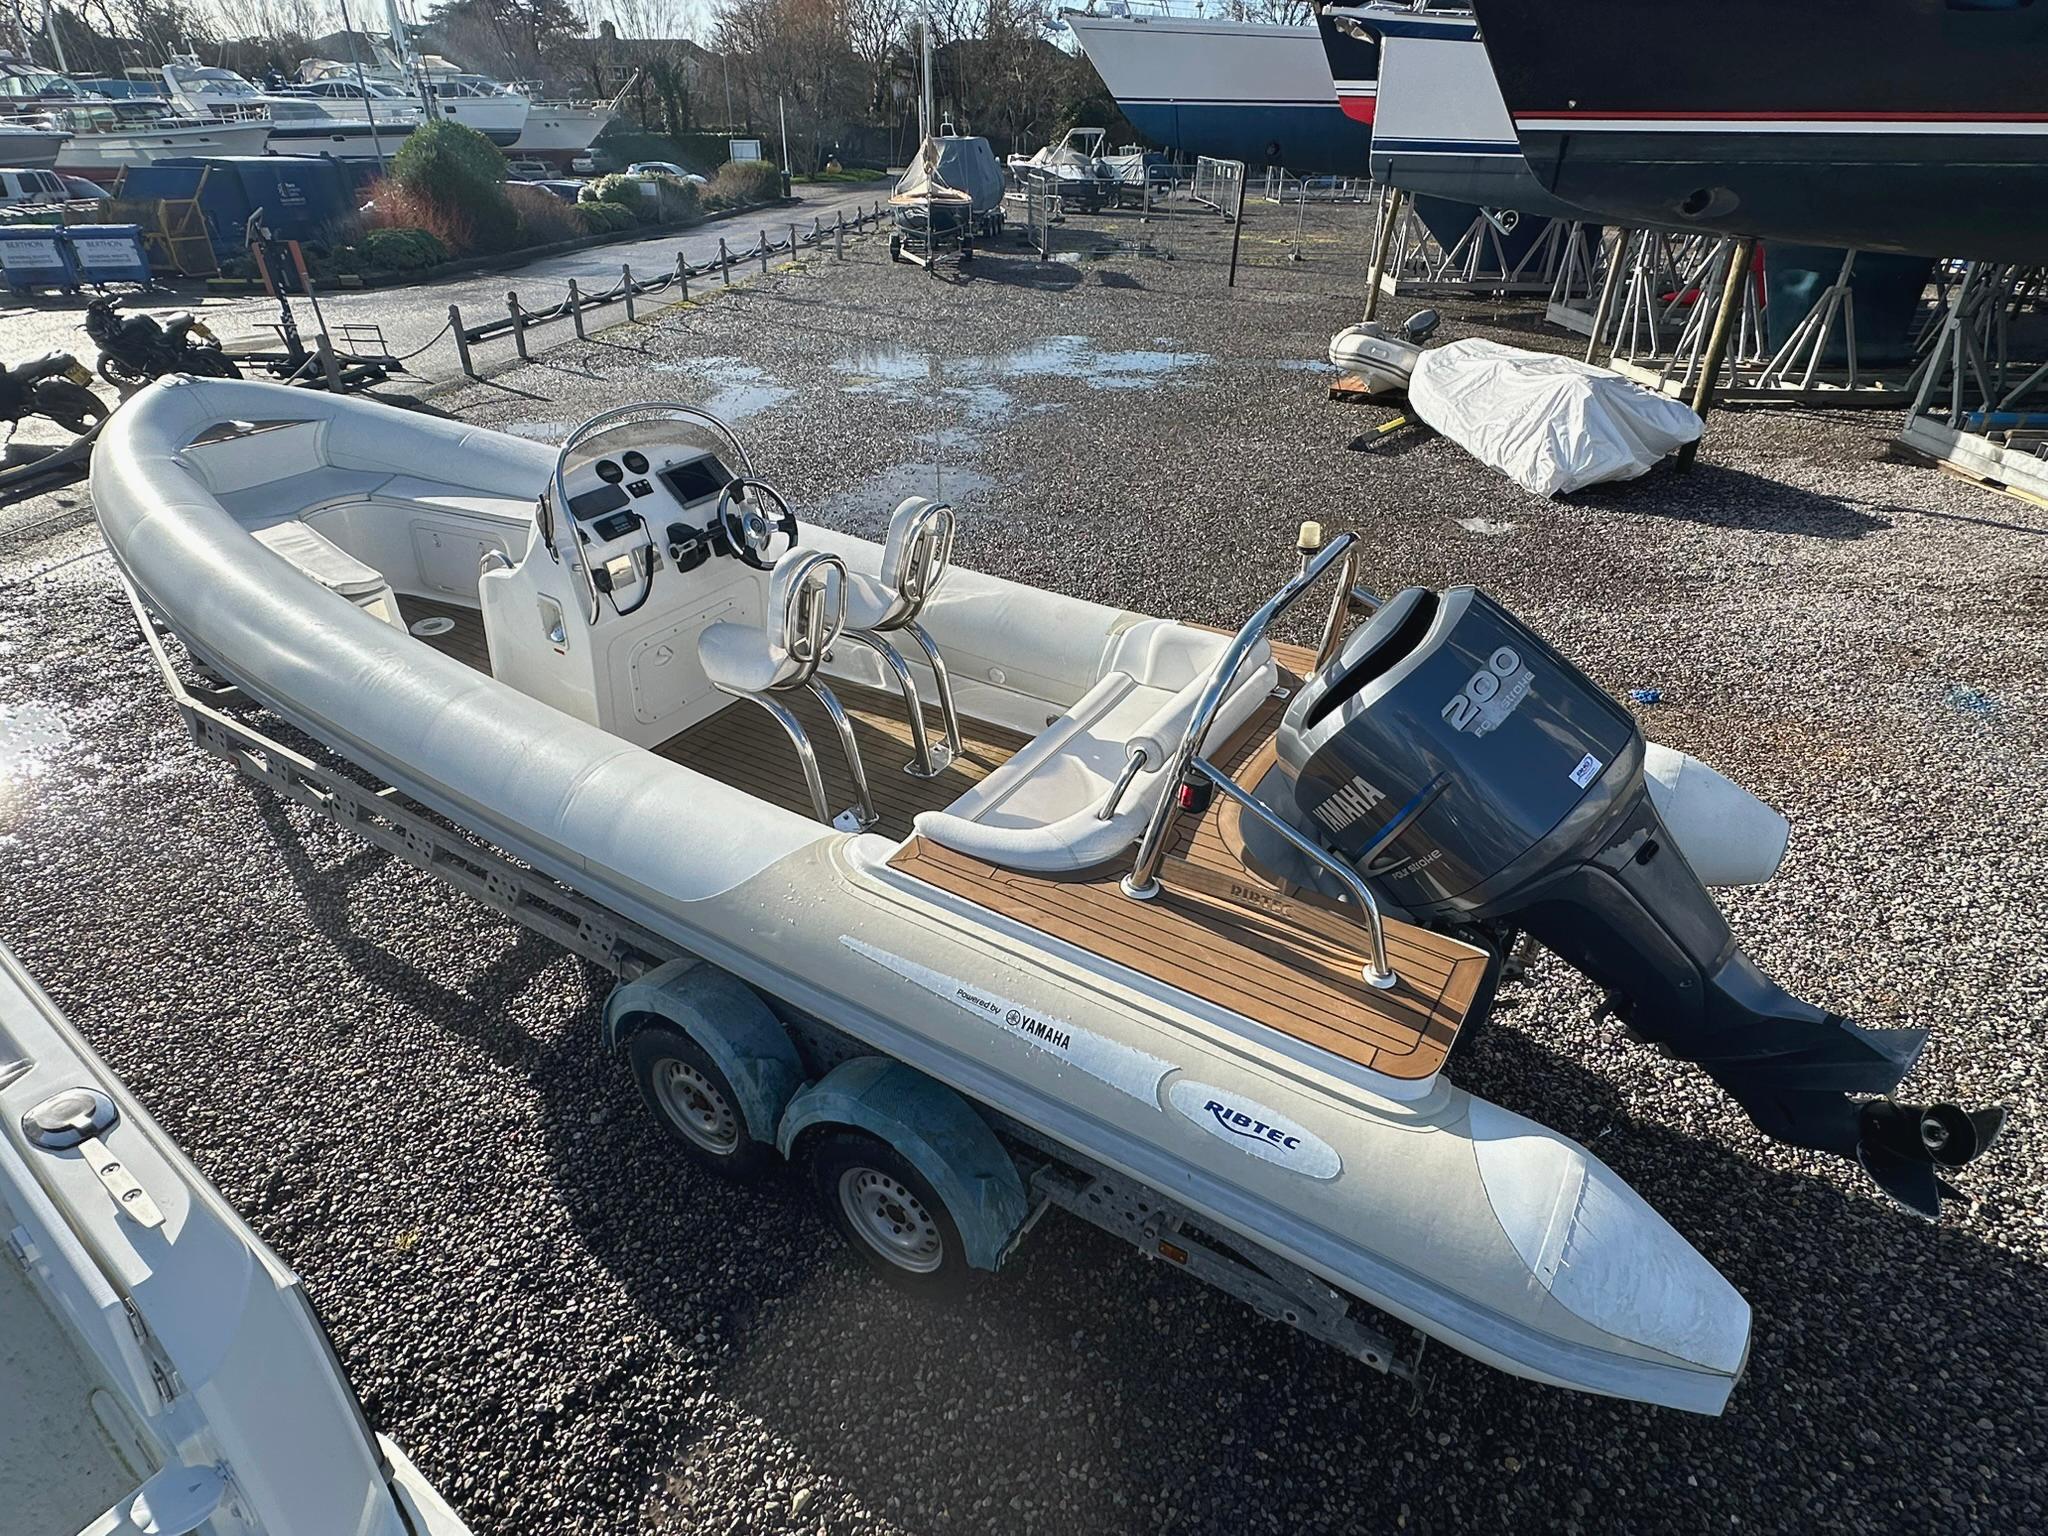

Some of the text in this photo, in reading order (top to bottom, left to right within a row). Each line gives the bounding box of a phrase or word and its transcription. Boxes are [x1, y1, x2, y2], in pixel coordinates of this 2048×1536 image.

[5, 241, 44, 249] BERTHON
[1441, 646, 1521, 731] 200
[1312, 775, 1386, 833] YAMAHA
[957, 988, 1071, 1050] Powered by YAMAHA
[1203, 1100, 1301, 1151] RIBTEC
